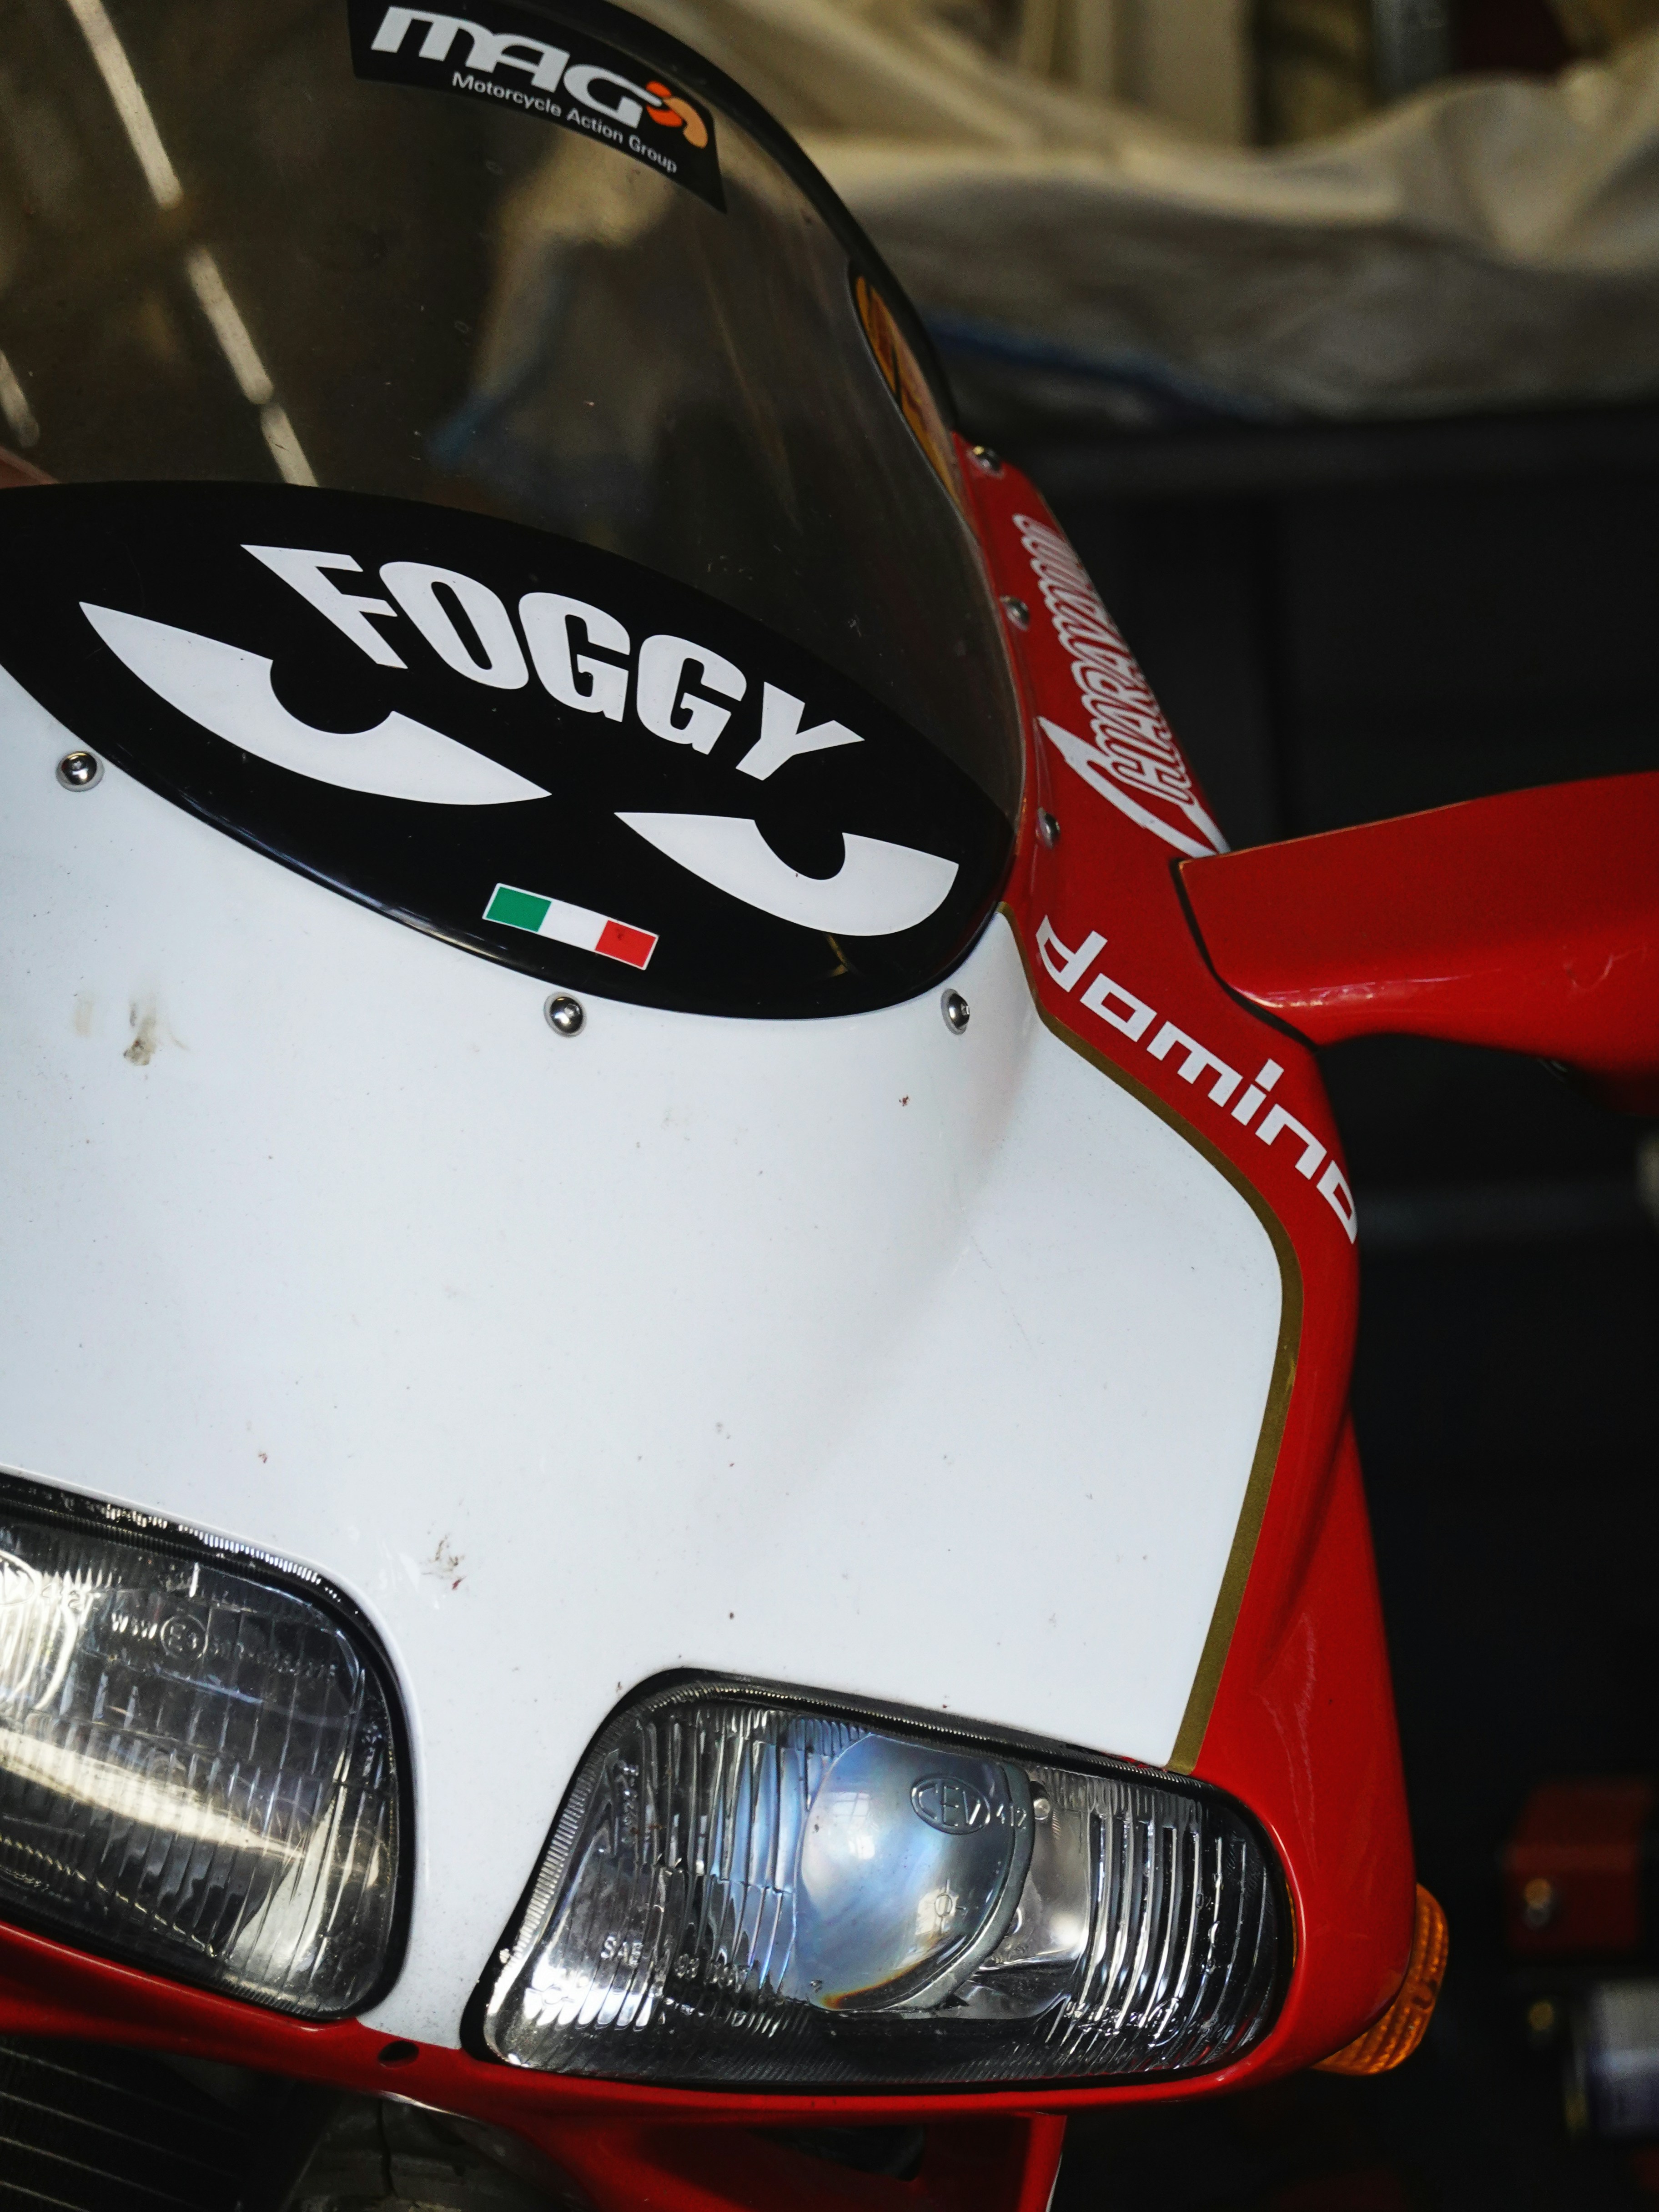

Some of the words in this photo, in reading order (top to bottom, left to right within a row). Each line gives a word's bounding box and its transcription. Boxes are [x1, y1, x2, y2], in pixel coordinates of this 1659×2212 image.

[452, 71, 562, 117] Motorcycle
[567, 108, 623, 144] Action
[628, 135, 678, 174] Group
[240, 544, 865, 781] FOGGY
[1035, 915, 1358, 1244] domino
